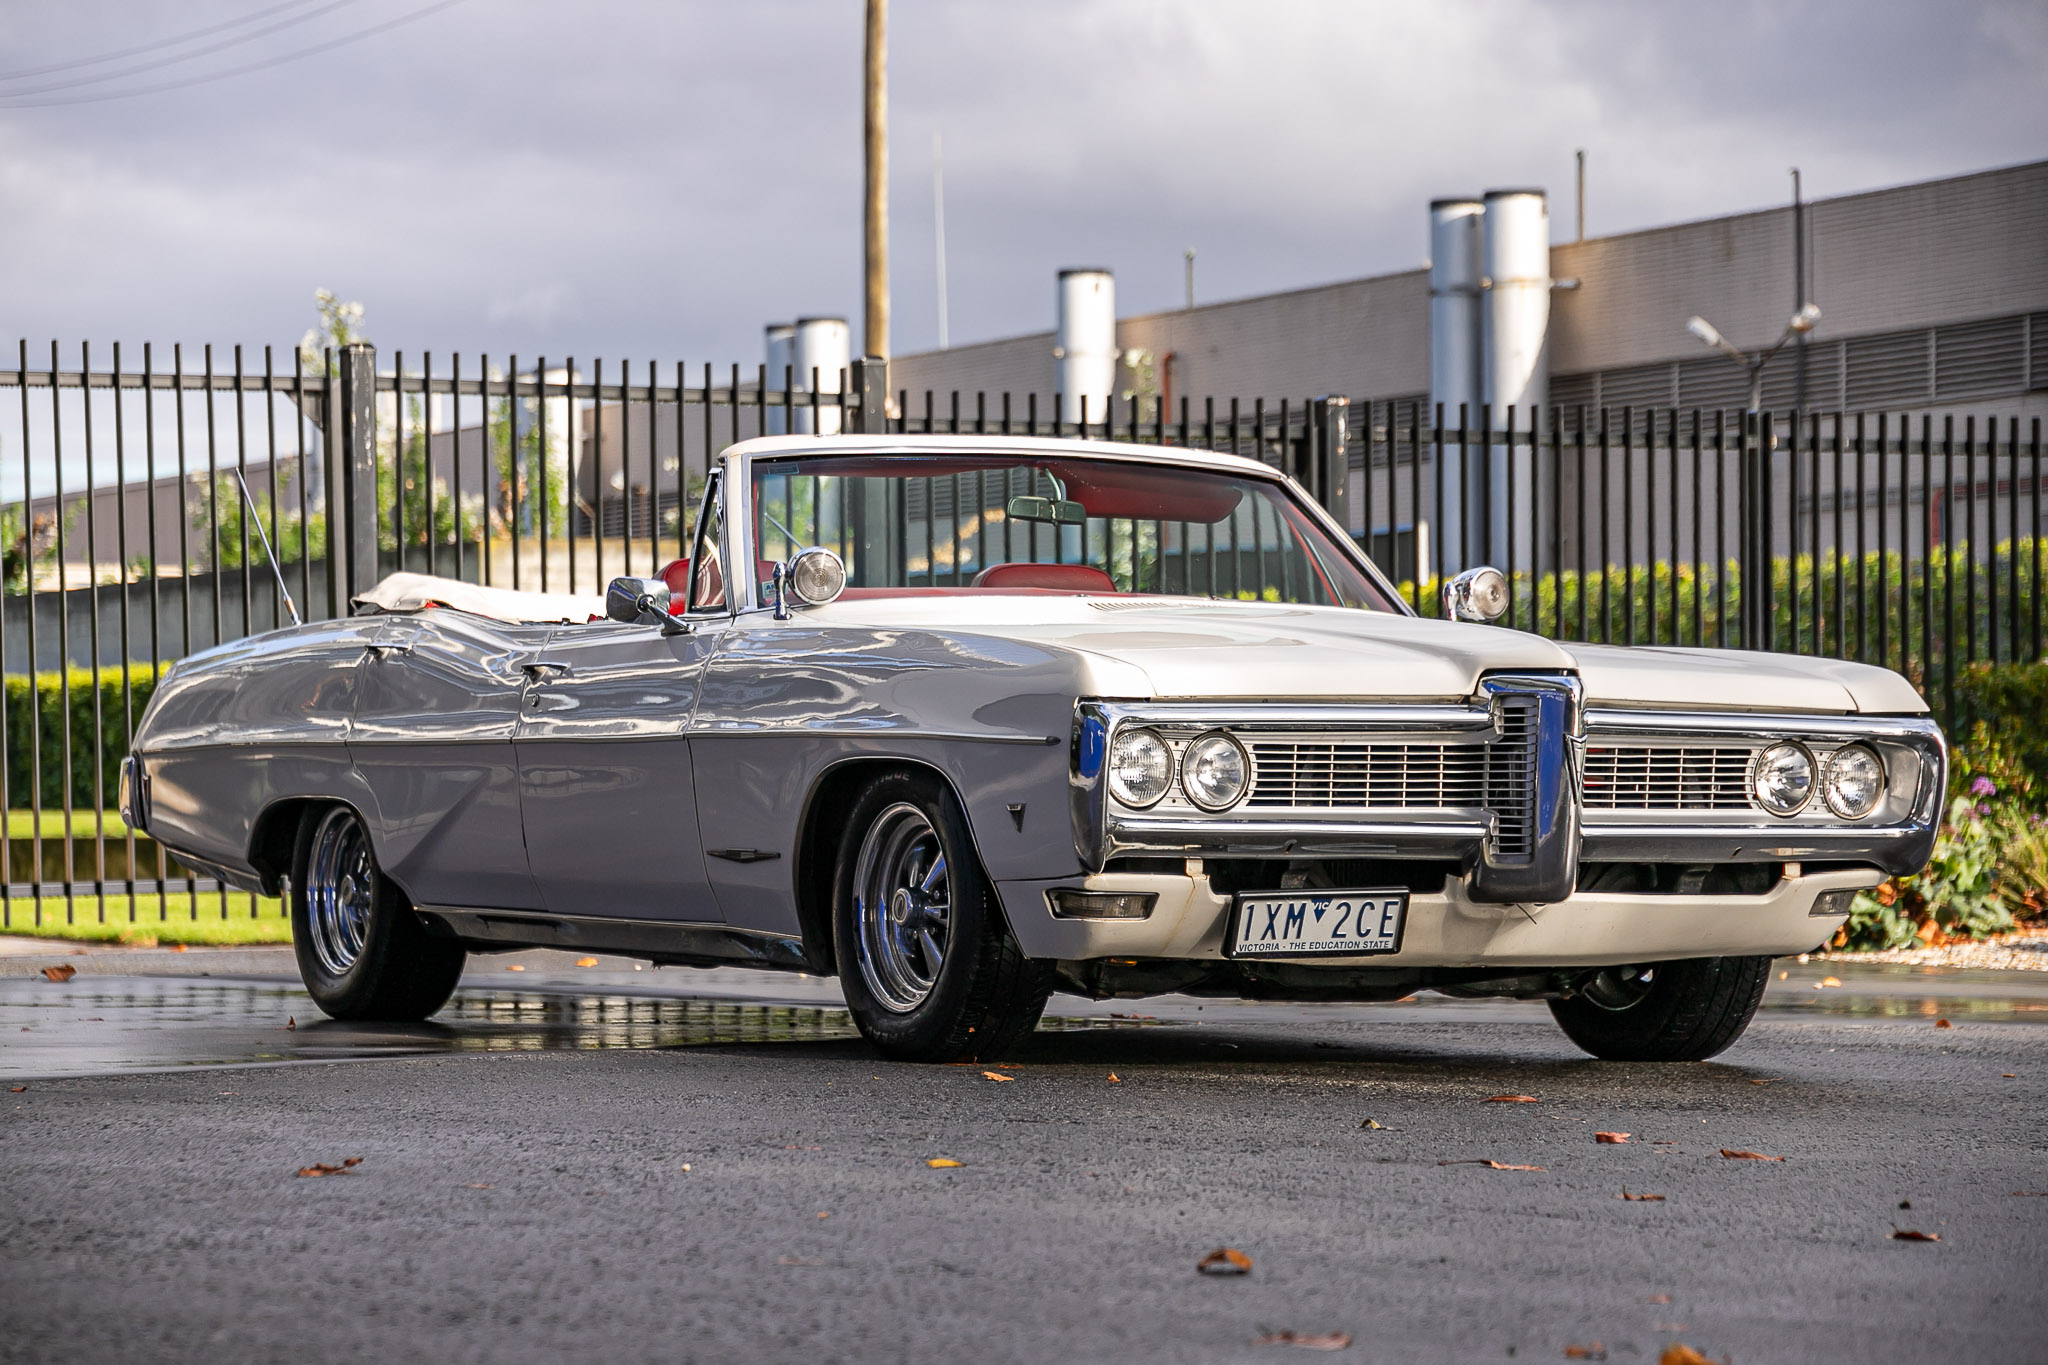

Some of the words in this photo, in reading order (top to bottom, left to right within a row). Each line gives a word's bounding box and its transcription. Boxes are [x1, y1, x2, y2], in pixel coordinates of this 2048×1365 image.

[1312, 902, 1329, 911] VIC
[1244, 903, 1307, 941] 1XM
[1331, 901, 1399, 938] 2CE
[1239, 943, 1280, 952] VICTORIA
[1289, 942, 1307, 950] THE
[1309, 941, 1360, 950] EDUCATION
[1363, 940, 1389, 949] STATE
